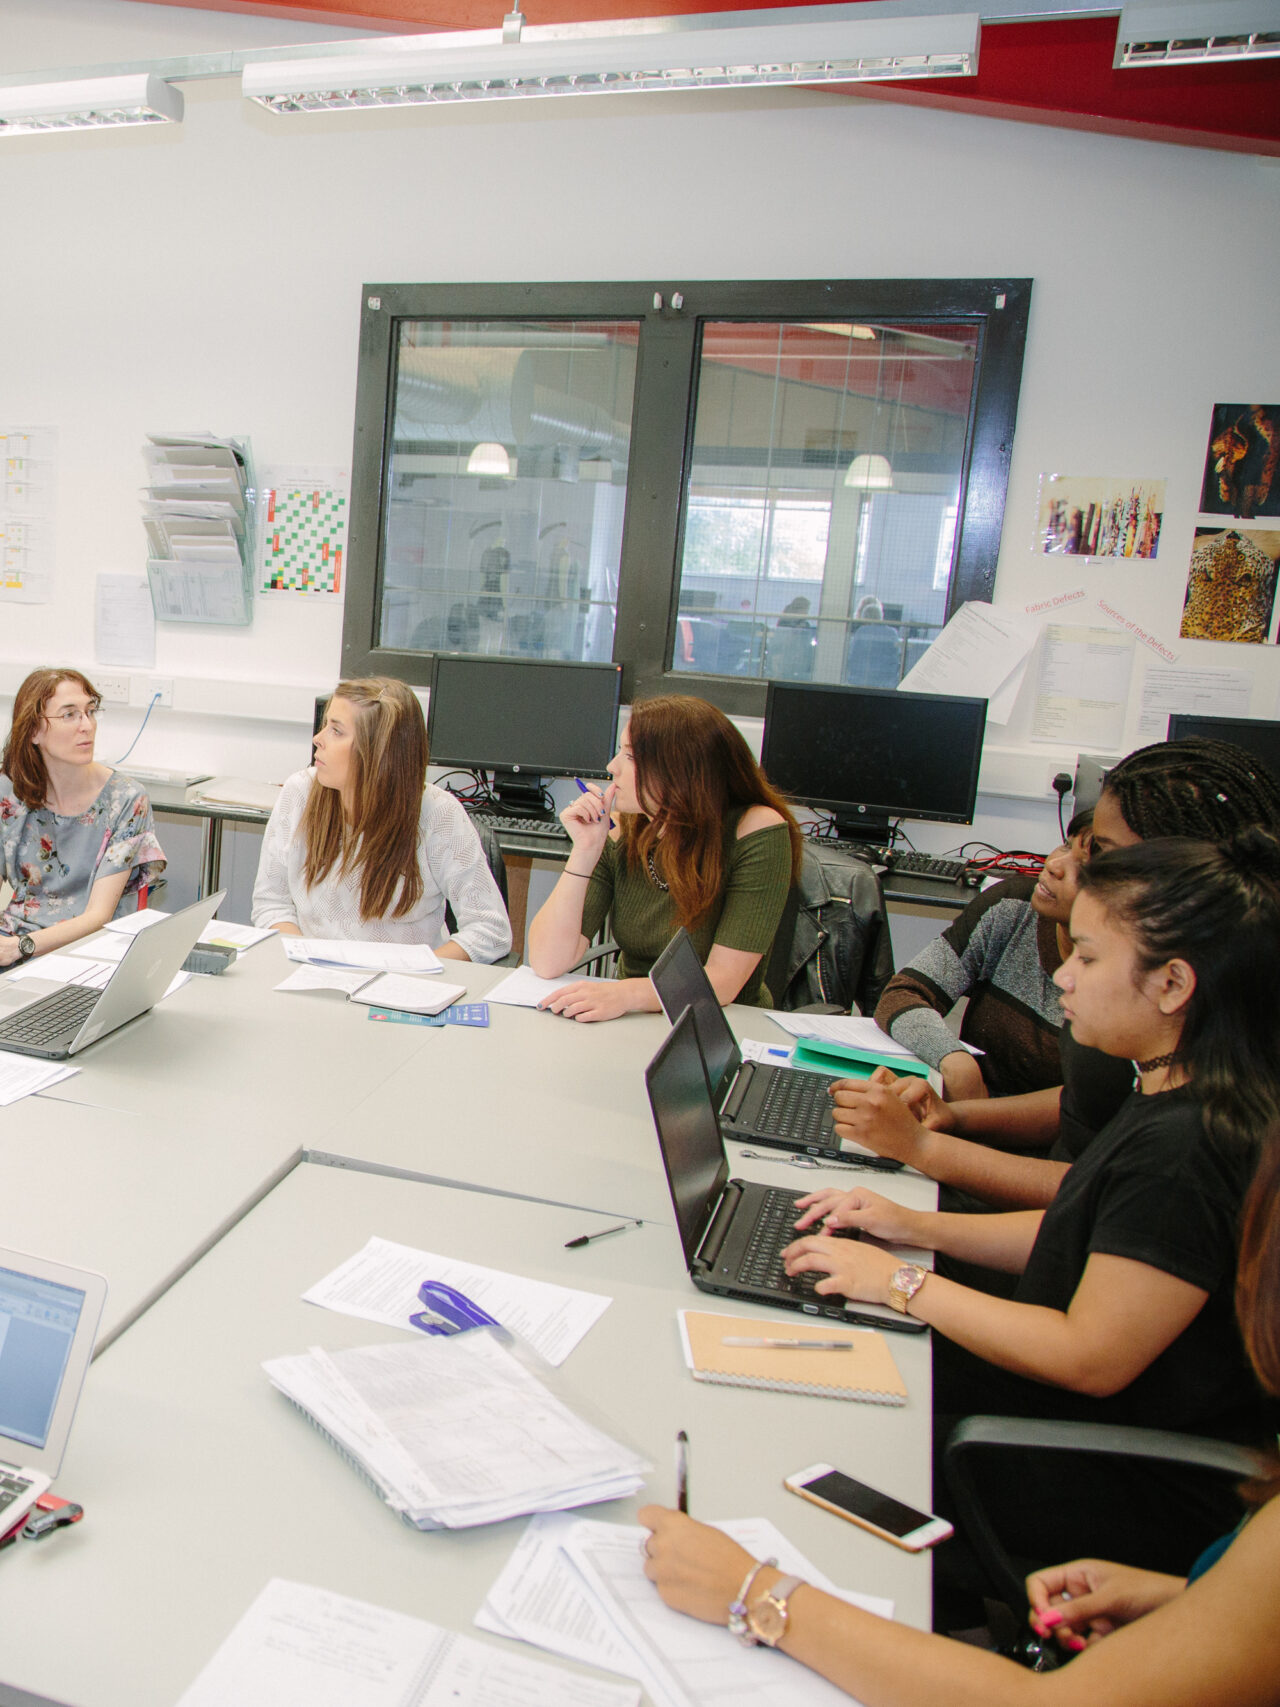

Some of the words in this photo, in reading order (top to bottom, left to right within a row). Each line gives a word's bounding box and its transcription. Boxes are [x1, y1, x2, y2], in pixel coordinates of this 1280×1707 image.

[1024, 599, 1051, 615] Fabric
[1051, 589, 1086, 607] Defects
[1096, 598, 1126, 625] Sources
[1133, 626, 1148, 640] the
[1146, 636, 1176, 661] Defects
